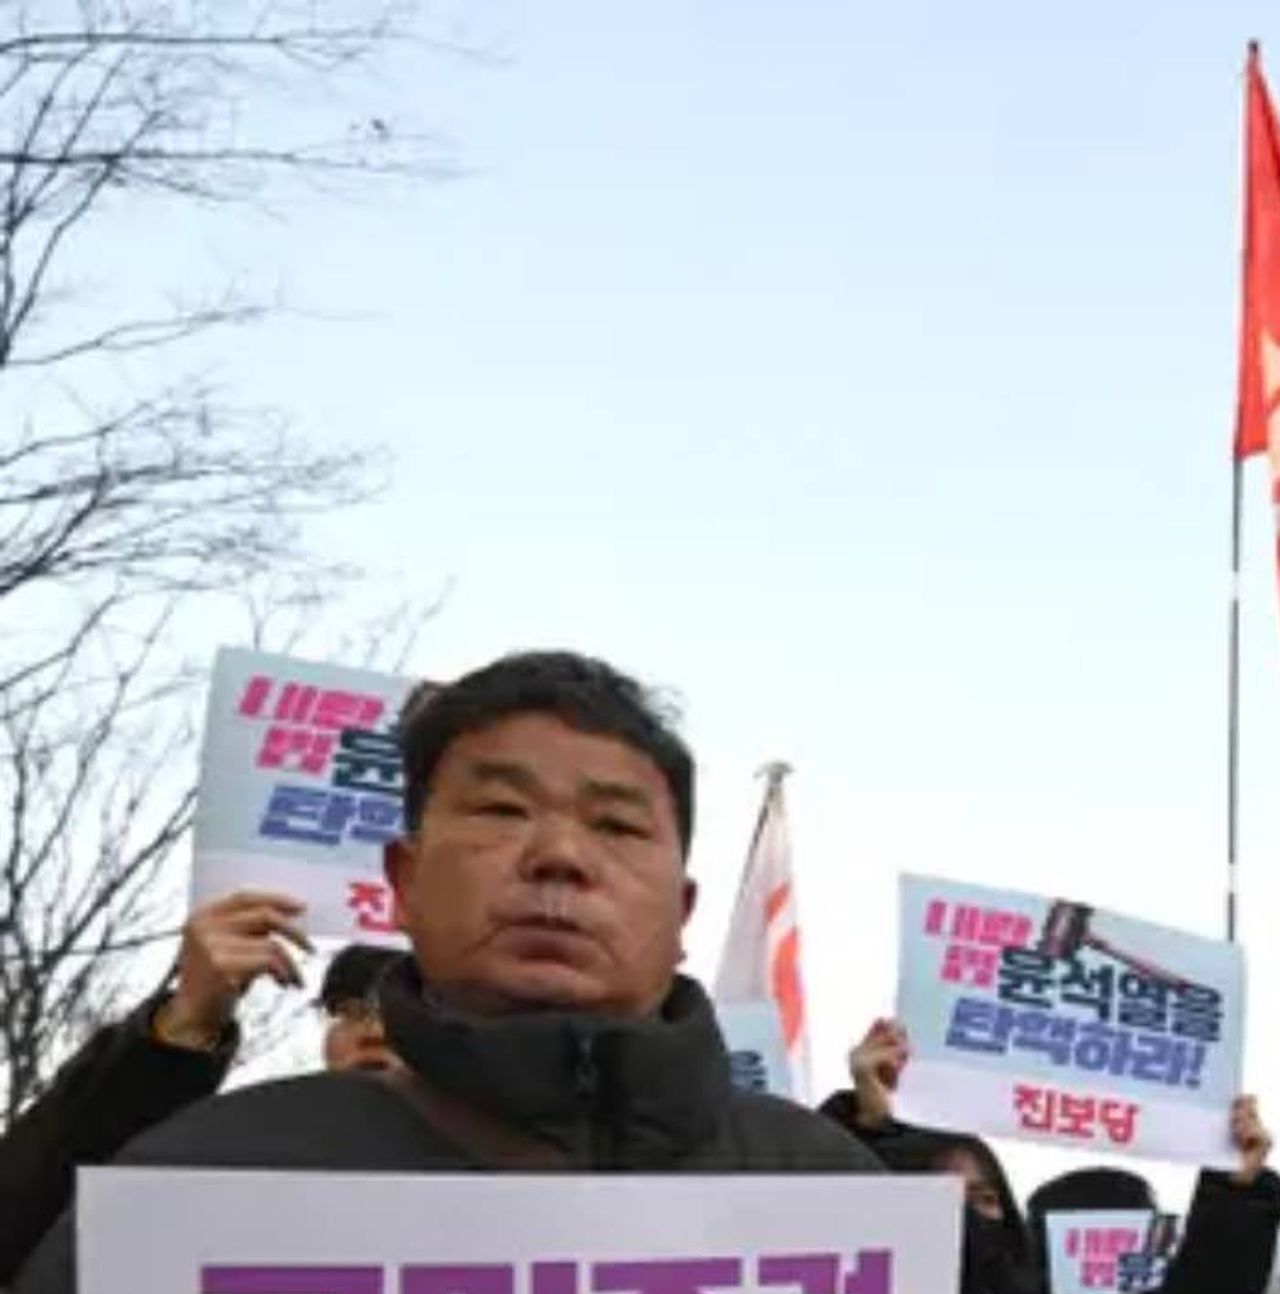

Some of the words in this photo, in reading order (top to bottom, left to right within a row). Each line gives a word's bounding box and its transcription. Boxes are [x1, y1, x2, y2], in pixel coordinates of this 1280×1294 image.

[998, 945, 1223, 1042] 윤석열을
[946, 998, 1206, 1090] 탄핵하라!
[1014, 1084, 1140, 1144] 진보당
